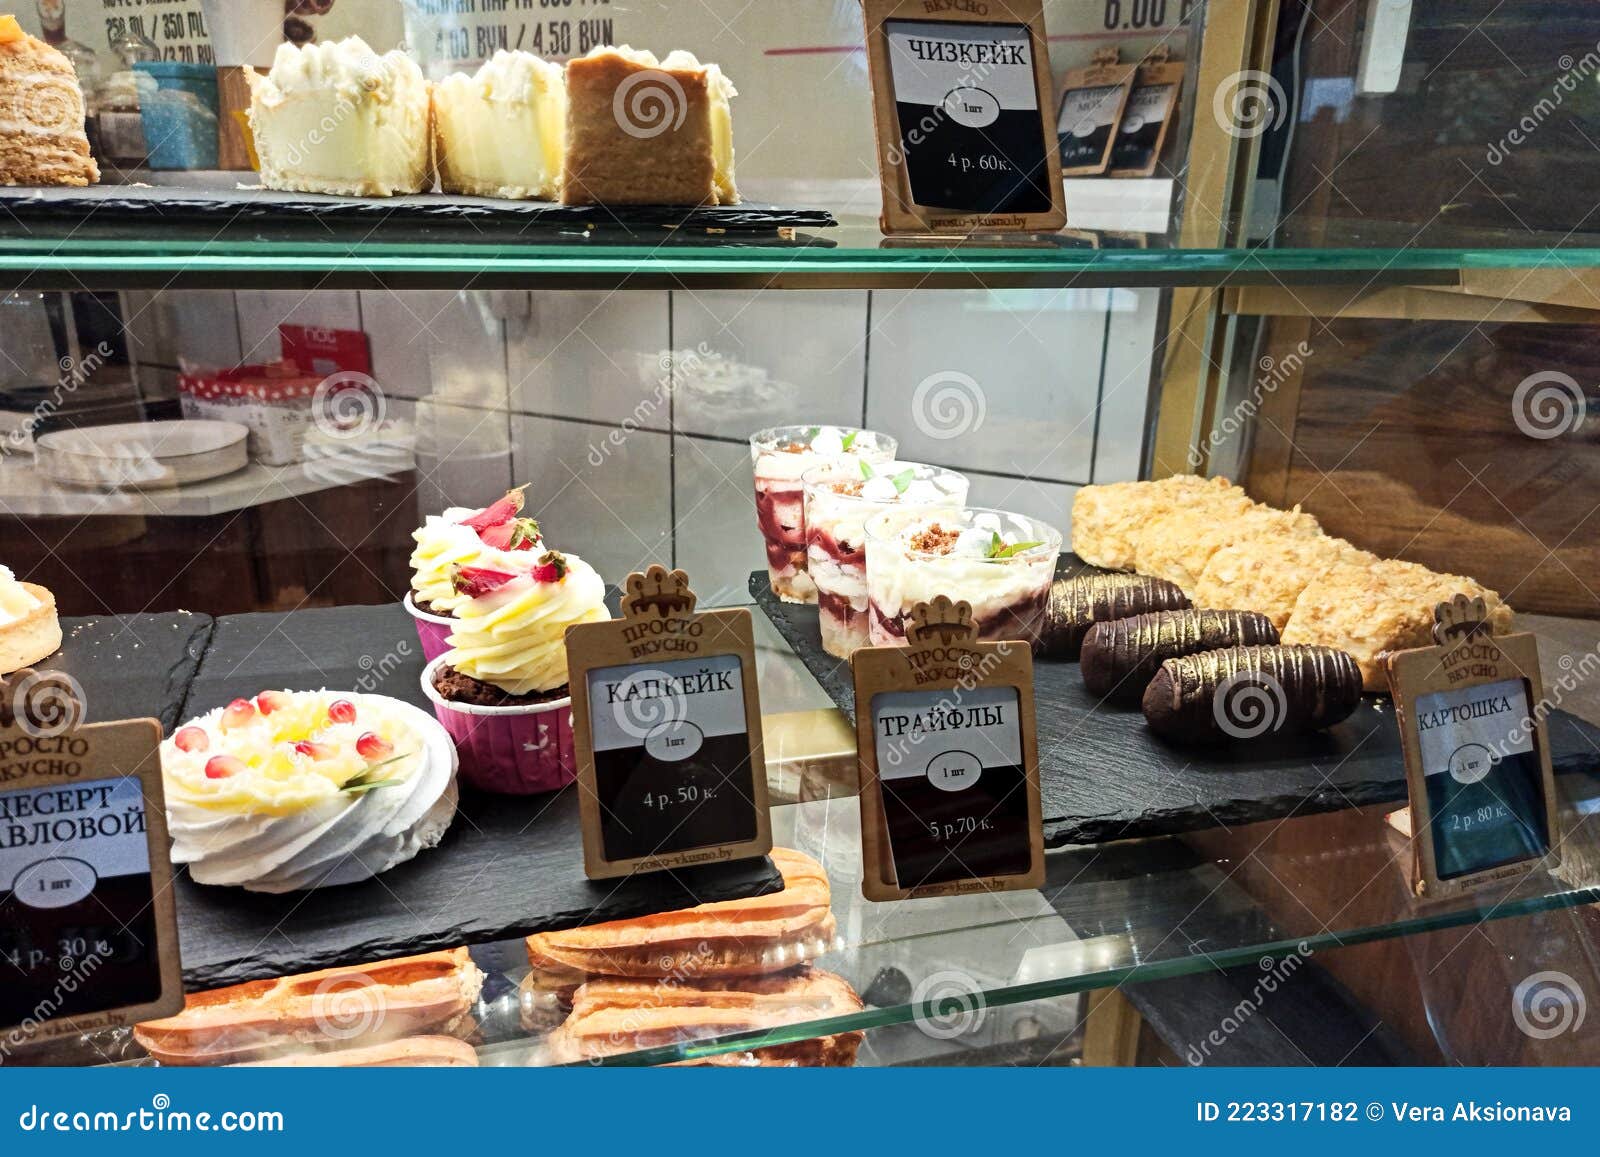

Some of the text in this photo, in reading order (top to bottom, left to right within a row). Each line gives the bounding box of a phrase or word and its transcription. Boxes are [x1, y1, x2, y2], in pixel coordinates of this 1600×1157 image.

[162, 13, 185, 40] 350
[533, 20, 571, 55] 4.50
[579, 18, 614, 54] BYN
[907, 38, 1027, 65] ЧИЗКЕЙК
[948, 152, 957, 167] 4
[622, 618, 704, 643] ПРОСТО
[630, 638, 699, 659] ВКУСНО
[1440, 644, 1501, 670] ПРОСТО
[1447, 663, 1498, 683] ВКУСНО
[606, 668, 735, 704] КАПКЕЙК
[879, 704, 1005, 737] ТРАЙФЛЫ
[1418, 695, 1513, 731] КАРТОШКА
[0, 735, 90, 760] РОСТО
[0, 758, 82, 781] КУСНО
[643, 792, 653, 807] 4
[658, 794, 673, 810] р.
[678, 785, 698, 802] 50
[0, 805, 147, 849] ВЛОВОЙ
[929, 821, 940, 838] 5
[1452, 814, 1460, 829] 2
[1477, 806, 1492, 822] 80
